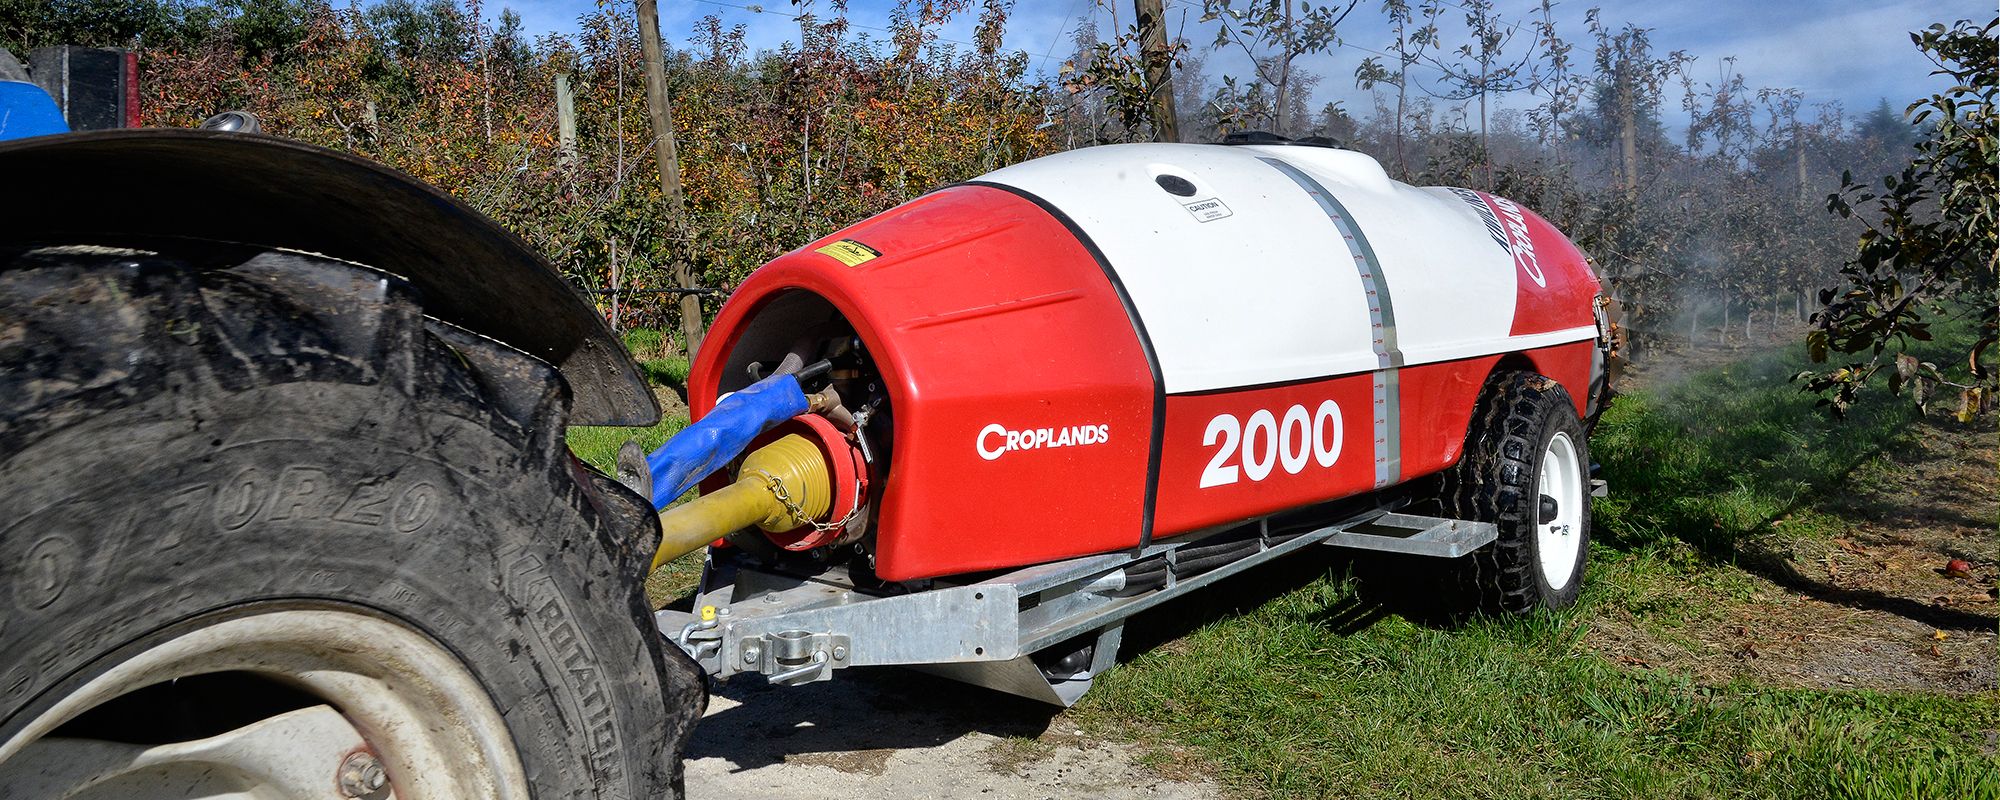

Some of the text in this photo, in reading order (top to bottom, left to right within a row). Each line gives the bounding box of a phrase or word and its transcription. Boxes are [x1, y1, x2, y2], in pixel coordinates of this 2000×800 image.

[1189, 201, 1220, 213] CAUTION
[976, 423, 1109, 461] CROPLANDS
[1200, 399, 1344, 489] 2000
